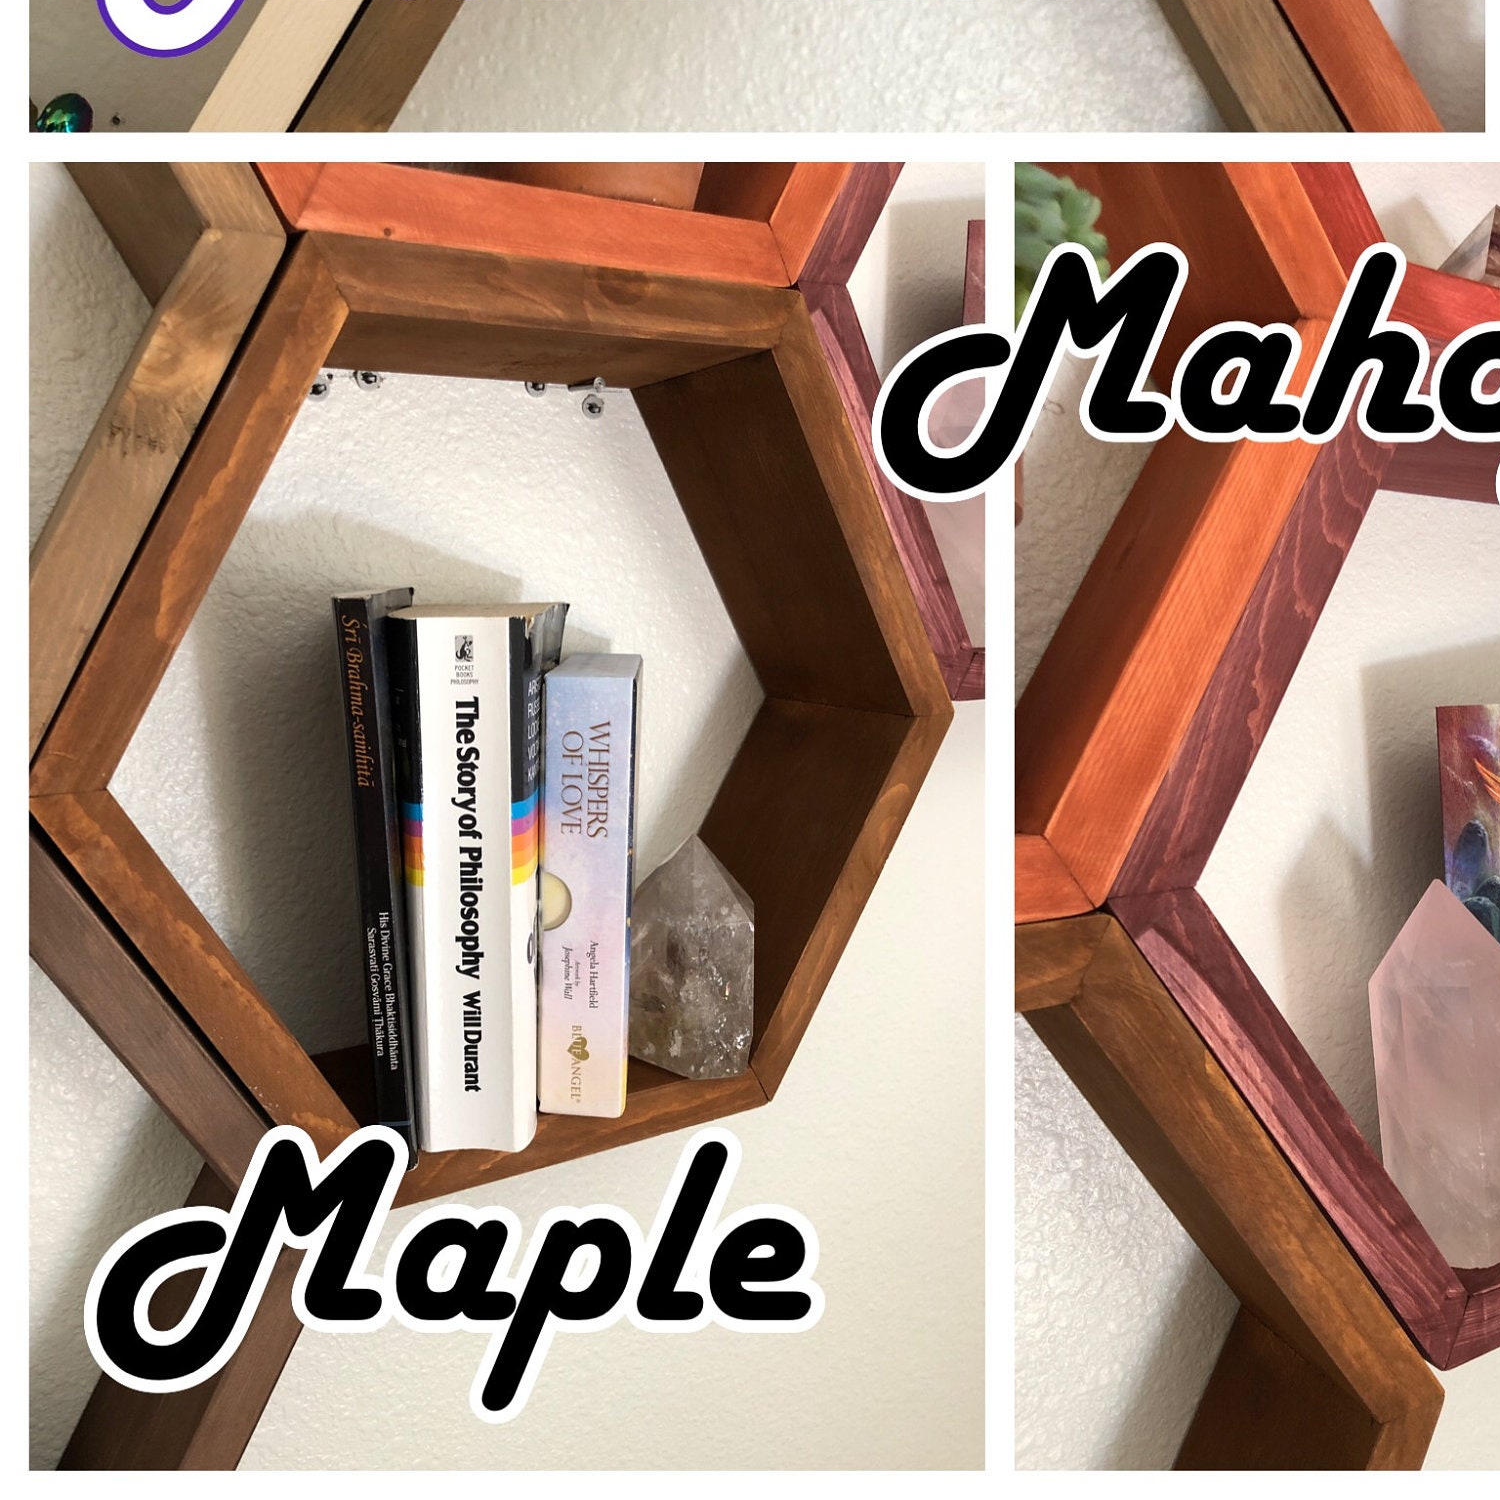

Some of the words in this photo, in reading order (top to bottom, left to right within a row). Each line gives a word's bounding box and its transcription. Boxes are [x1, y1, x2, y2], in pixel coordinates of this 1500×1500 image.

[456, 696, 480, 744] The
[562, 730, 584, 766] OF
[451, 746, 480, 813] Story
[587, 721, 610, 838] WHISPERS
[561, 774, 582, 834] LOVE
[458, 813, 482, 840] of
[379, 912, 389, 928] His
[455, 846, 484, 980] Philosophy
[380, 930, 391, 961] Divine
[561, 946, 573, 981] Josephine
[586, 940, 599, 969] Angela
[383, 962, 393, 991] Grace
[564, 982, 573, 1000] Wall
[589, 971, 599, 1008] Hartfield
[463, 990, 482, 1027] Will
[571, 1025, 582, 1056] BLUE
[464, 1030, 482, 1092] Durant
